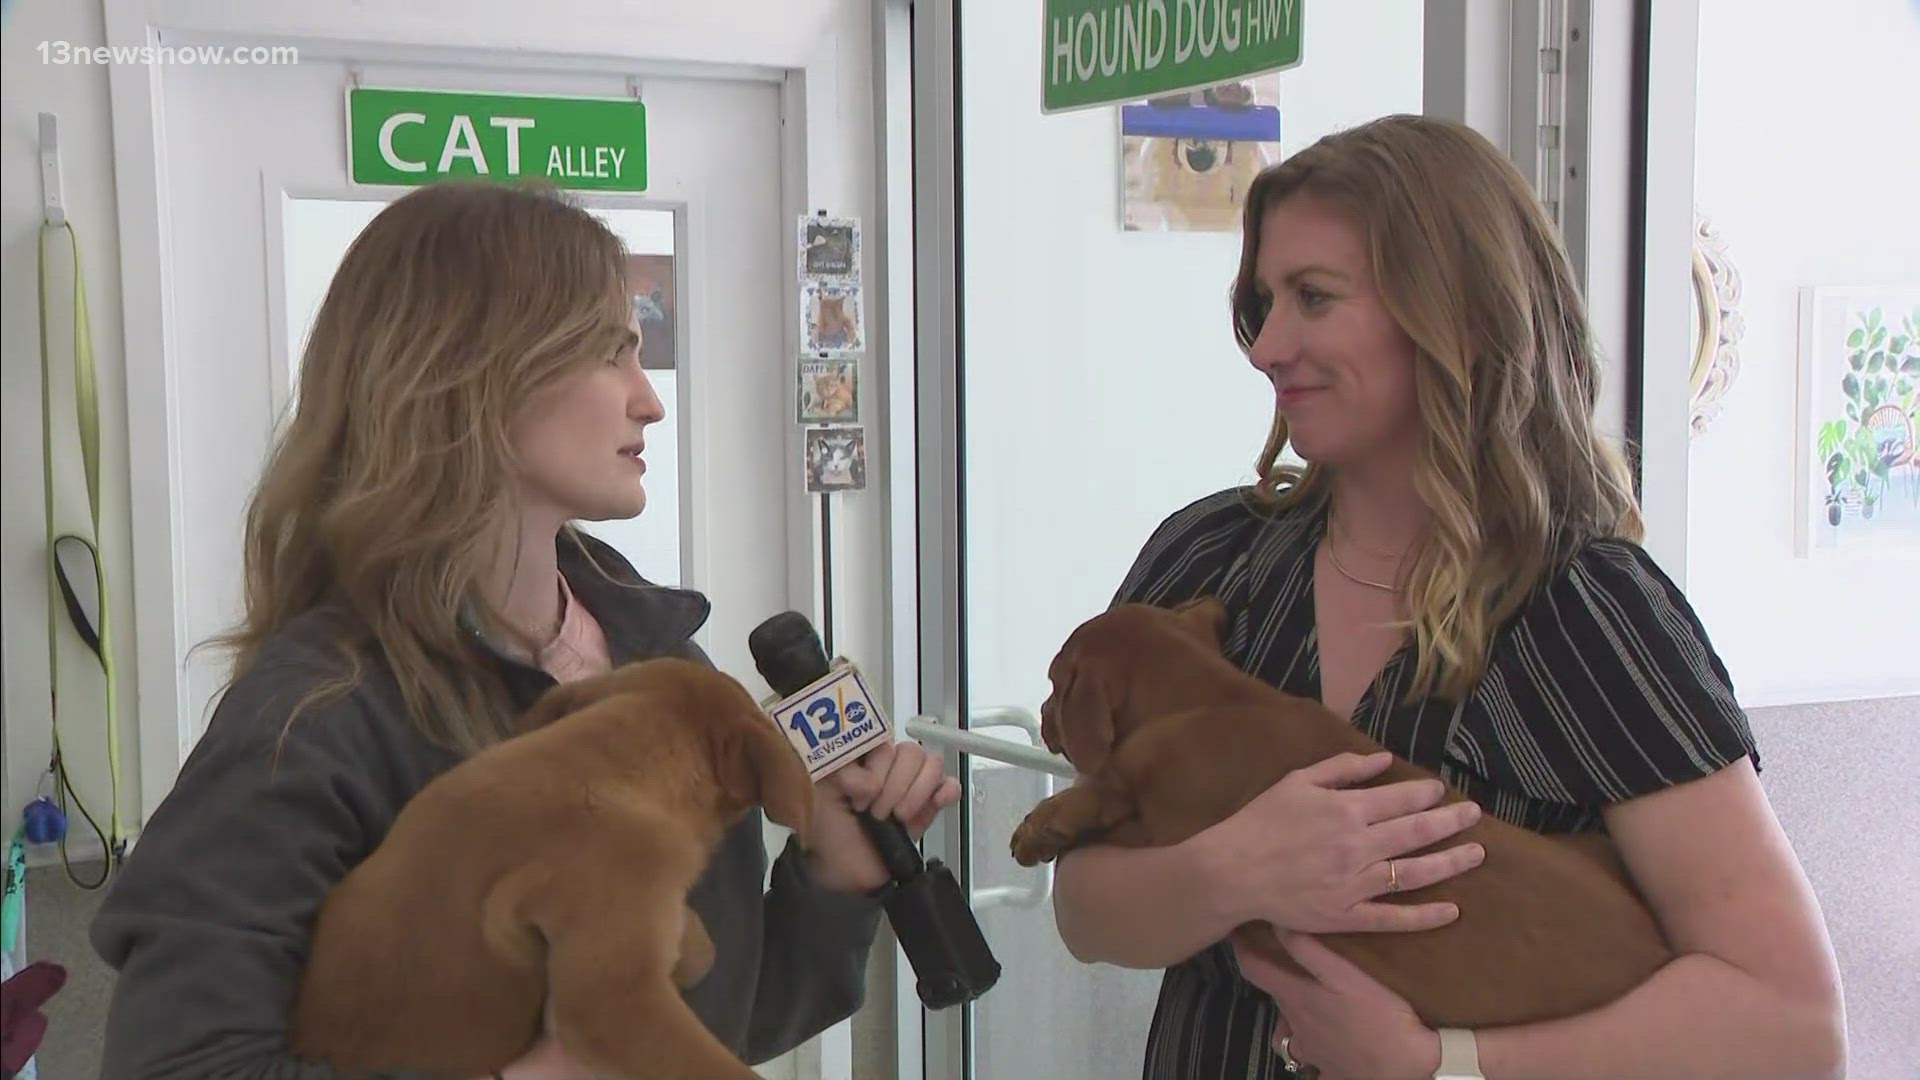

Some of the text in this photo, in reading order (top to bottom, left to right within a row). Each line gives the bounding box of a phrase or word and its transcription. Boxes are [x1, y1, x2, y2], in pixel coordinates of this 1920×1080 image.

[1052, 0, 1294, 86] HOUND DOG HWY
[378, 112, 626, 178] CAT ALLEY
